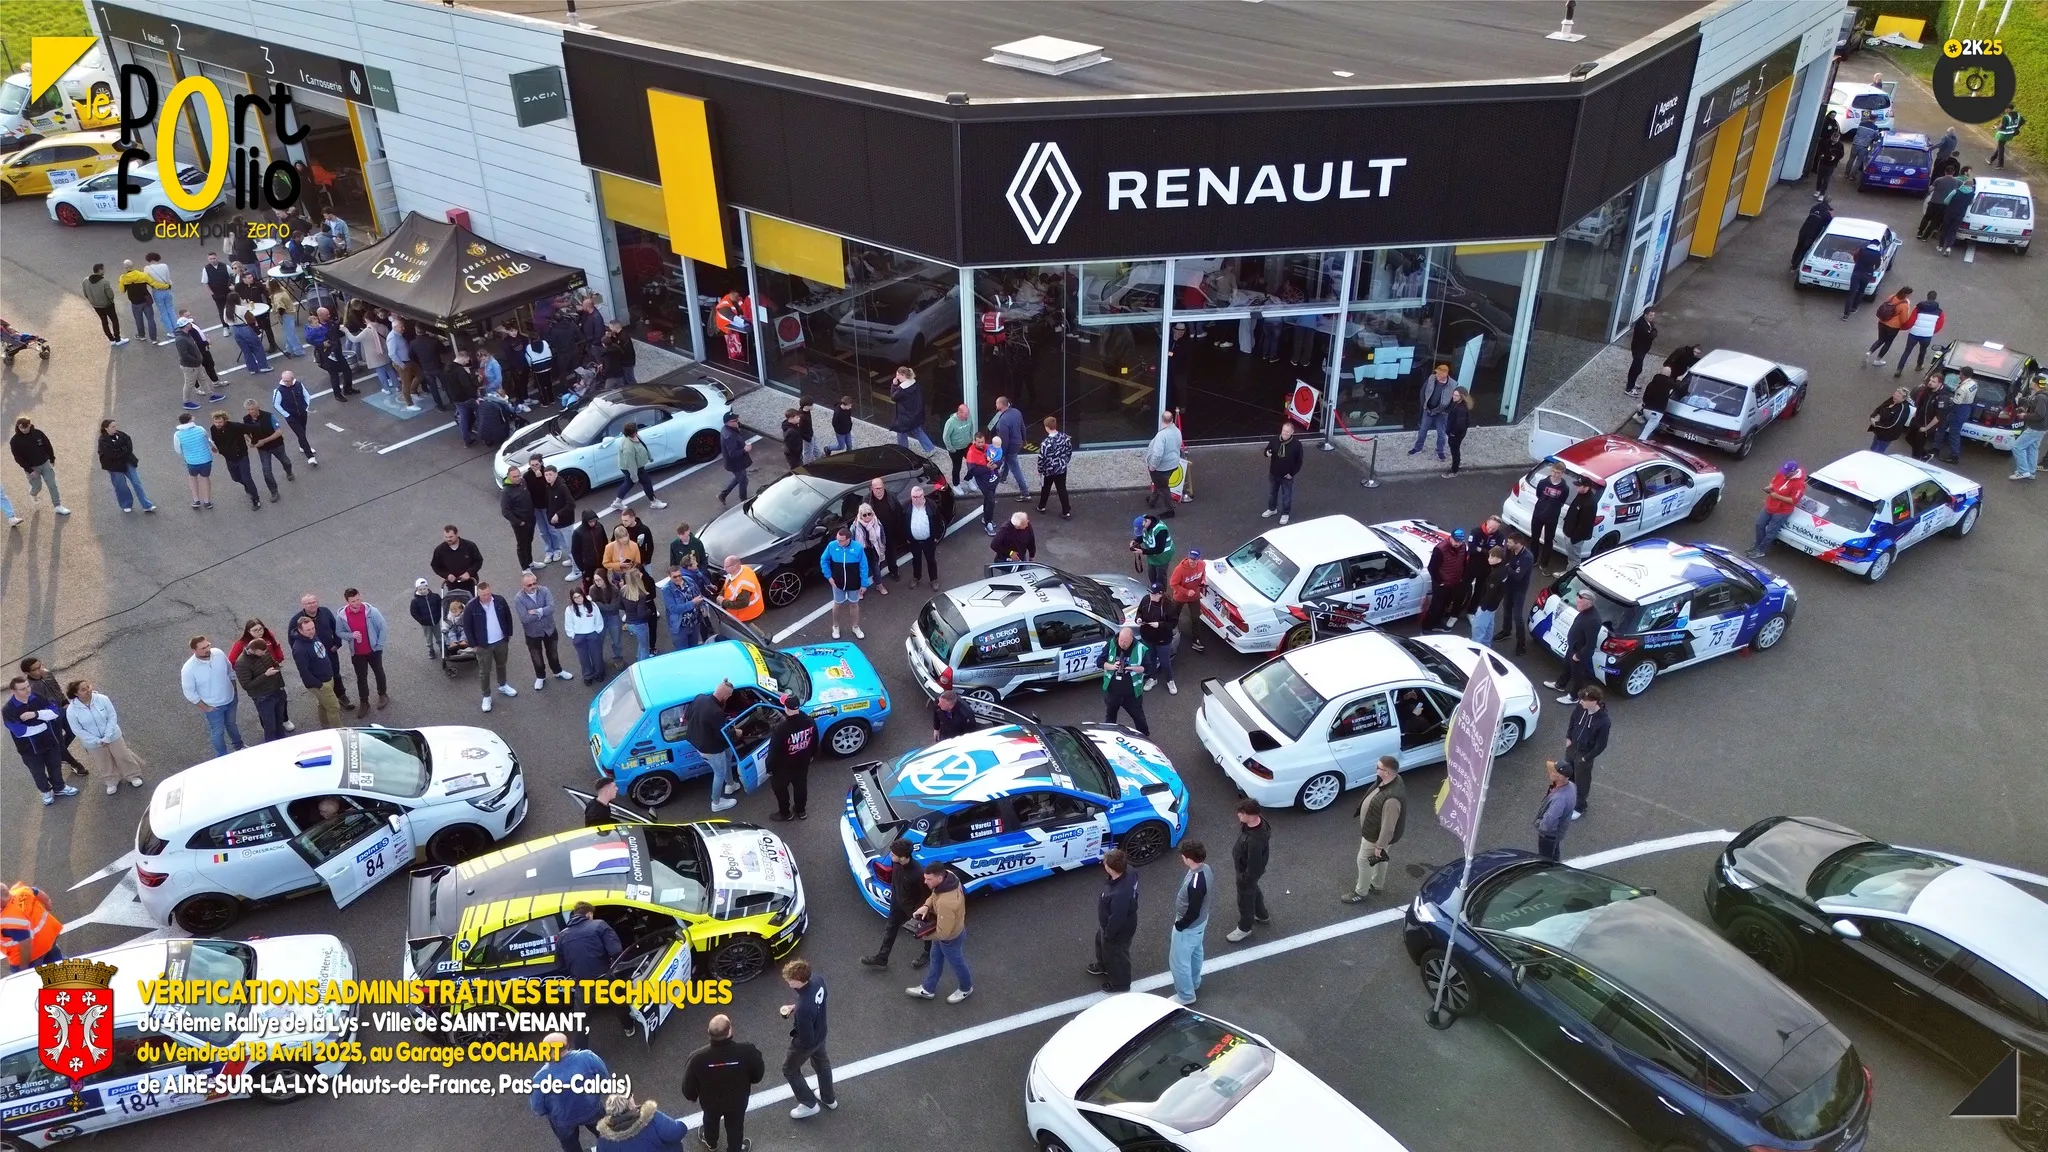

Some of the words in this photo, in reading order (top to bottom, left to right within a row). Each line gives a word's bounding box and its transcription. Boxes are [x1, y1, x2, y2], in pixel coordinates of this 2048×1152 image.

[170, 23, 185, 51] 2
[259, 45, 276, 75] 3
[305, 74, 343, 93] Carrosserie
[1755, 63, 1768, 95] 5
[522, 91, 558, 103] DACIA
[1658, 95, 1679, 116] Agence
[1703, 97, 1715, 127] 4
[1653, 116, 1675, 137] Cochart
[1108, 158, 1407, 211] RENAULT
[371, 256, 422, 285] Goudale
[462, 252, 511, 274] BRASSERIE
[464, 261, 532, 294] Goudale
[1373, 593, 1395, 612] 302
[996, 628, 1018, 639] DEROO
[998, 637, 1020, 648] DEROO
[1709, 630, 1725, 648] 73
[1557, 640, 1568, 652] 73
[1065, 656, 1088, 675] 127
[790, 731, 809, 745] WTF
[1115, 736, 1147, 757] AUTO
[360, 775, 373, 785] 84
[853, 773, 882, 821] CONTROLAUTO
[1051, 831, 1074, 842] point
[357, 844, 382, 863] point
[627, 836, 643, 882] CONTROLAUTO
[762, 836, 780, 863] AUTO
[1062, 841, 1068, 858] 1
[366, 853, 385, 878] 84
[996, 856, 1036, 872] AUTO
[15, 1078, 49, 1090] Salmon
[19, 1086, 45, 1097] Poivre
[3, 1096, 67, 1119] PEUGEOT
[116, 1094, 160, 1115] 184
